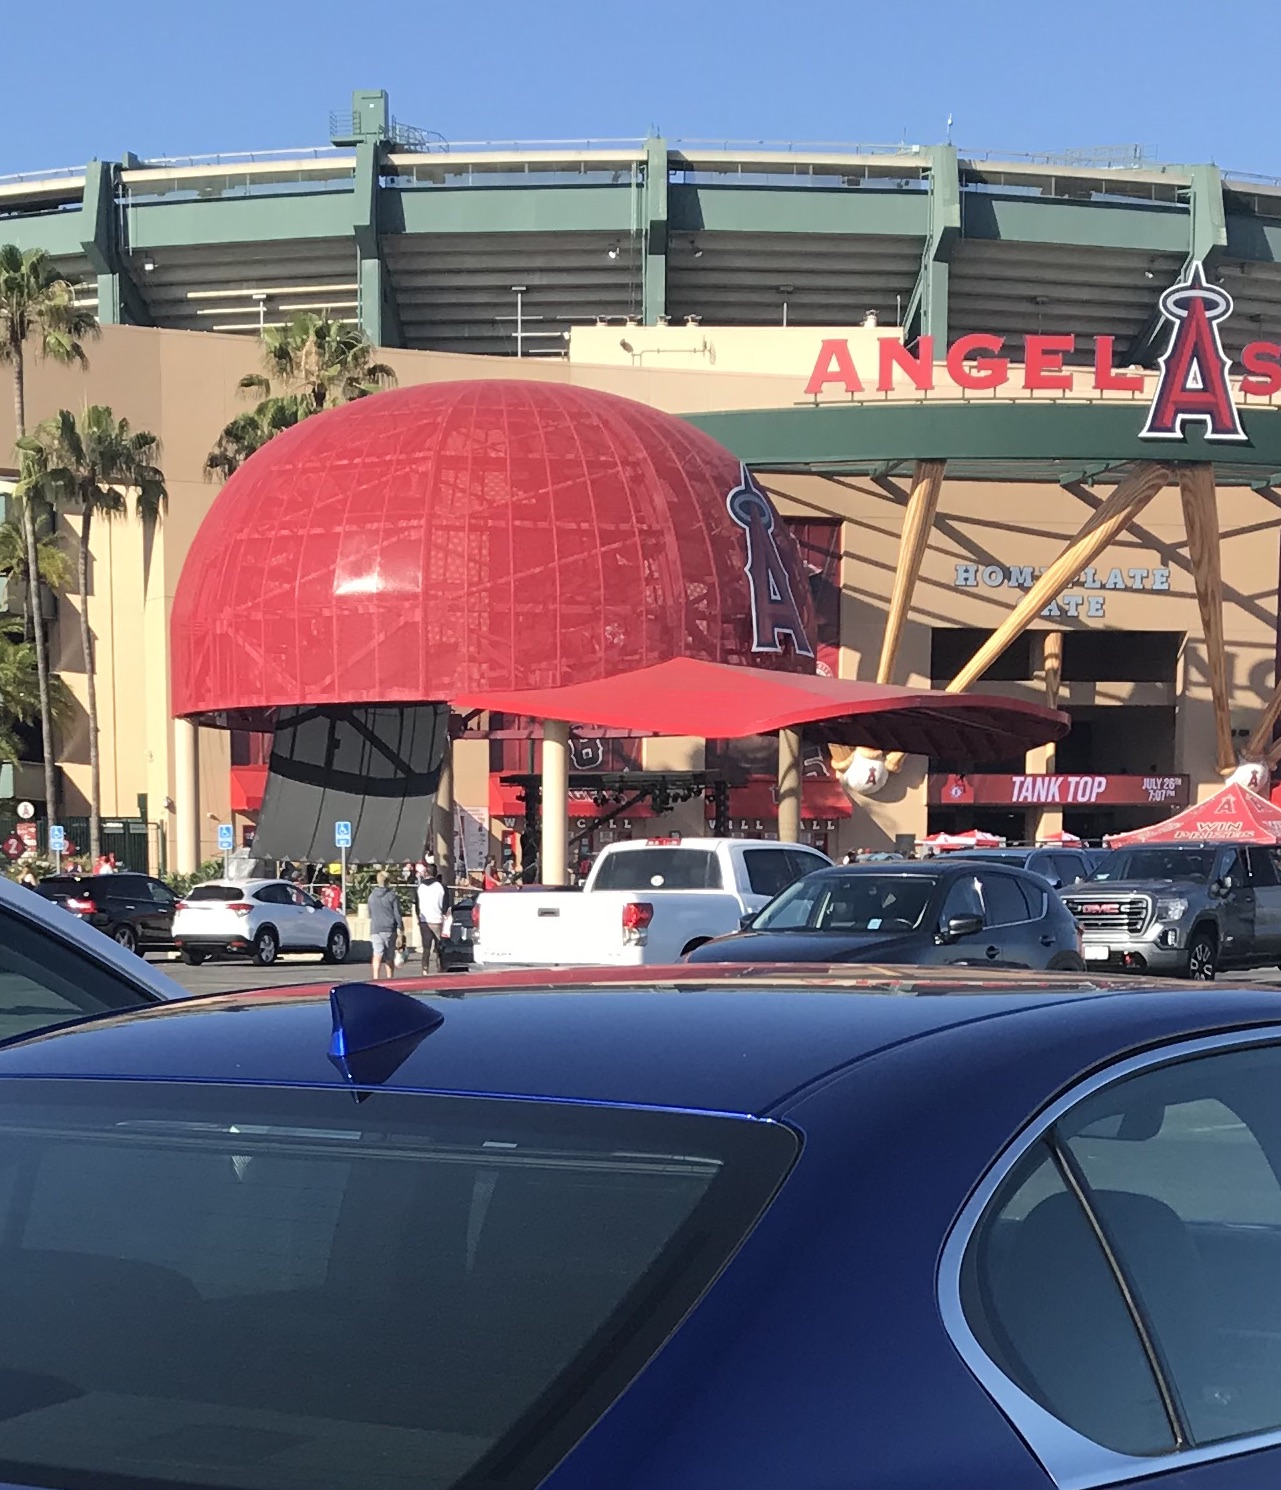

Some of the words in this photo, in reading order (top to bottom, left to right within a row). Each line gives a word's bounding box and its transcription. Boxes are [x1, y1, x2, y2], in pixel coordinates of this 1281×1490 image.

[804, 333, 1145, 395] ANGEL
[1011, 776, 1064, 803] TANK
[1067, 776, 1107, 803] TOP
[1142, 777, 1162, 790] JULY
[1196, 821, 1243, 832] WIN
